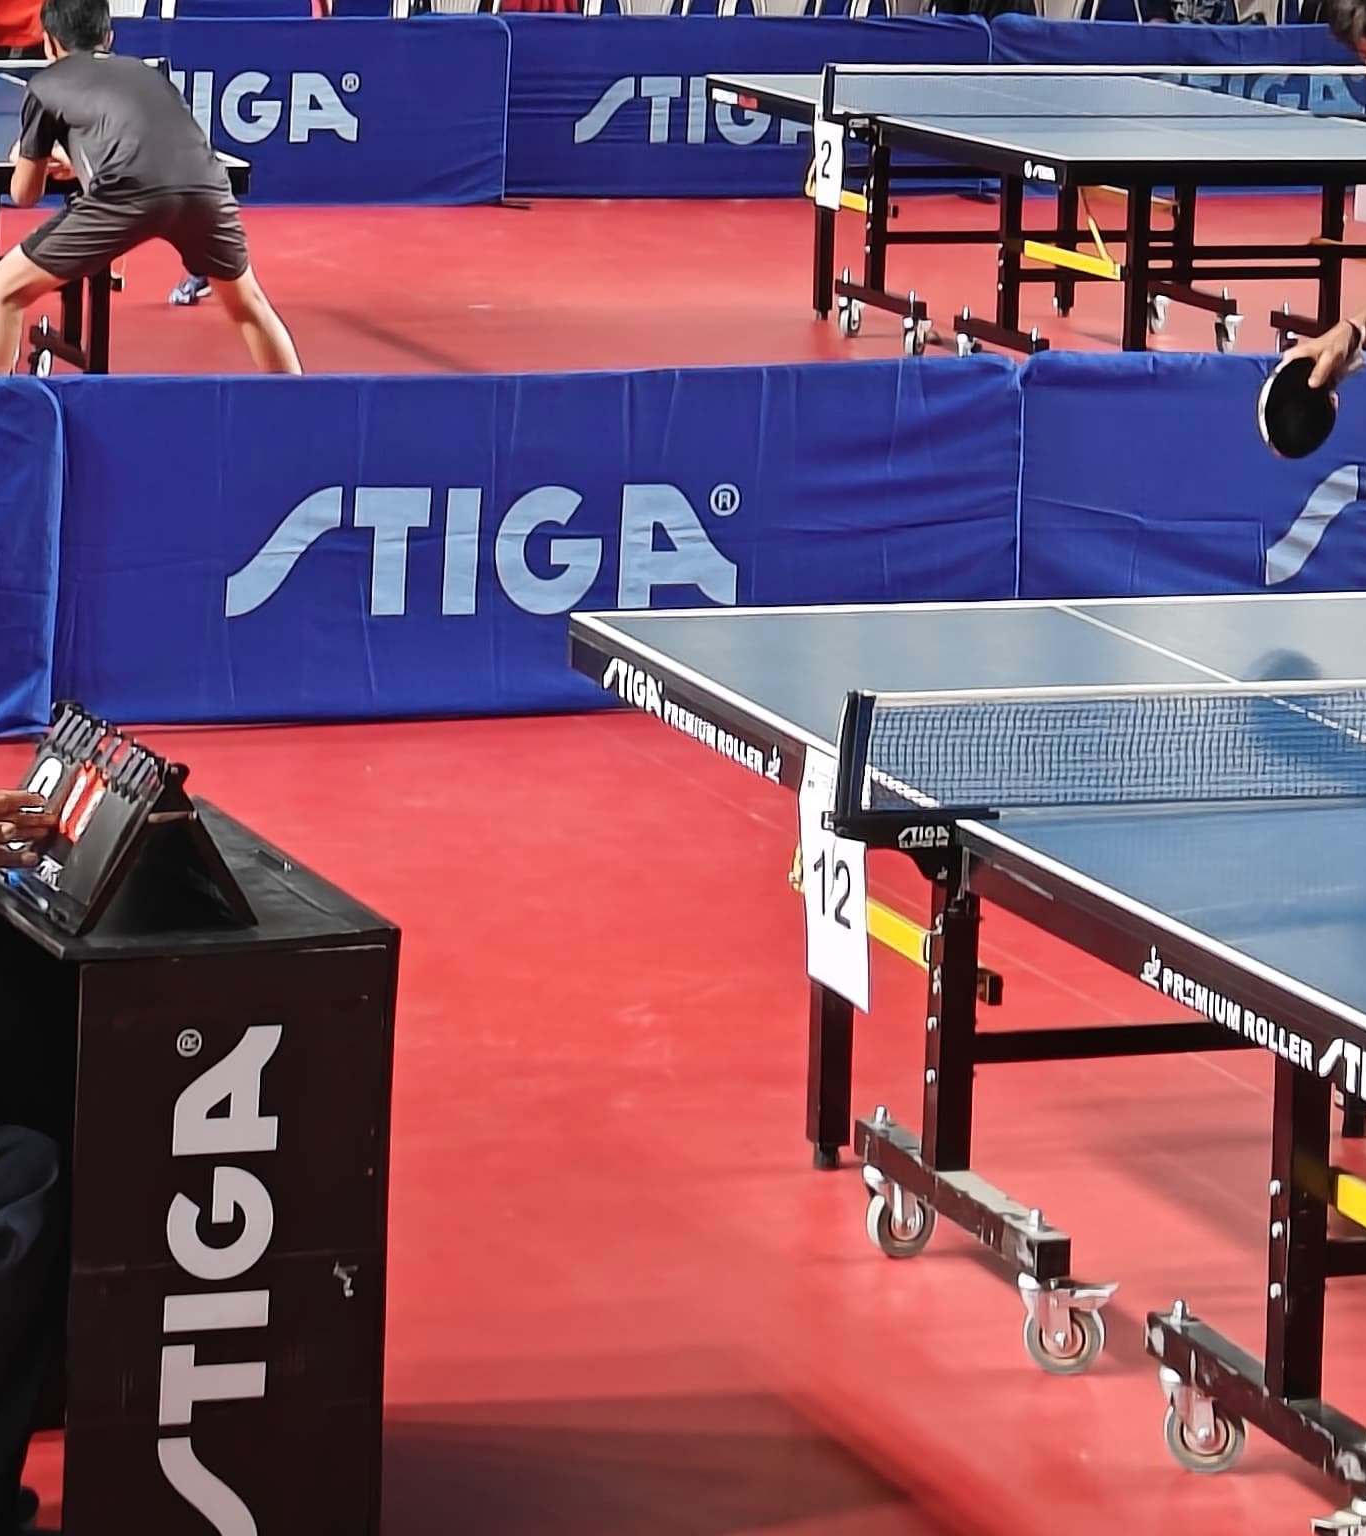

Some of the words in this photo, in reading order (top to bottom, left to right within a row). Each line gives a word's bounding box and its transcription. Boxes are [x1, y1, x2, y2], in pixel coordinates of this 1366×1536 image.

[821, 140, 831, 179] 2
[603, 657, 664, 718] STIGA
[664, 700, 717, 751] PREMIUM
[717, 730, 764, 776] ROLLER
[814, 848, 852, 930] 12
[1162, 968, 1241, 1034] PREMIUM
[1243, 1009, 1314, 1072] ROLLER
